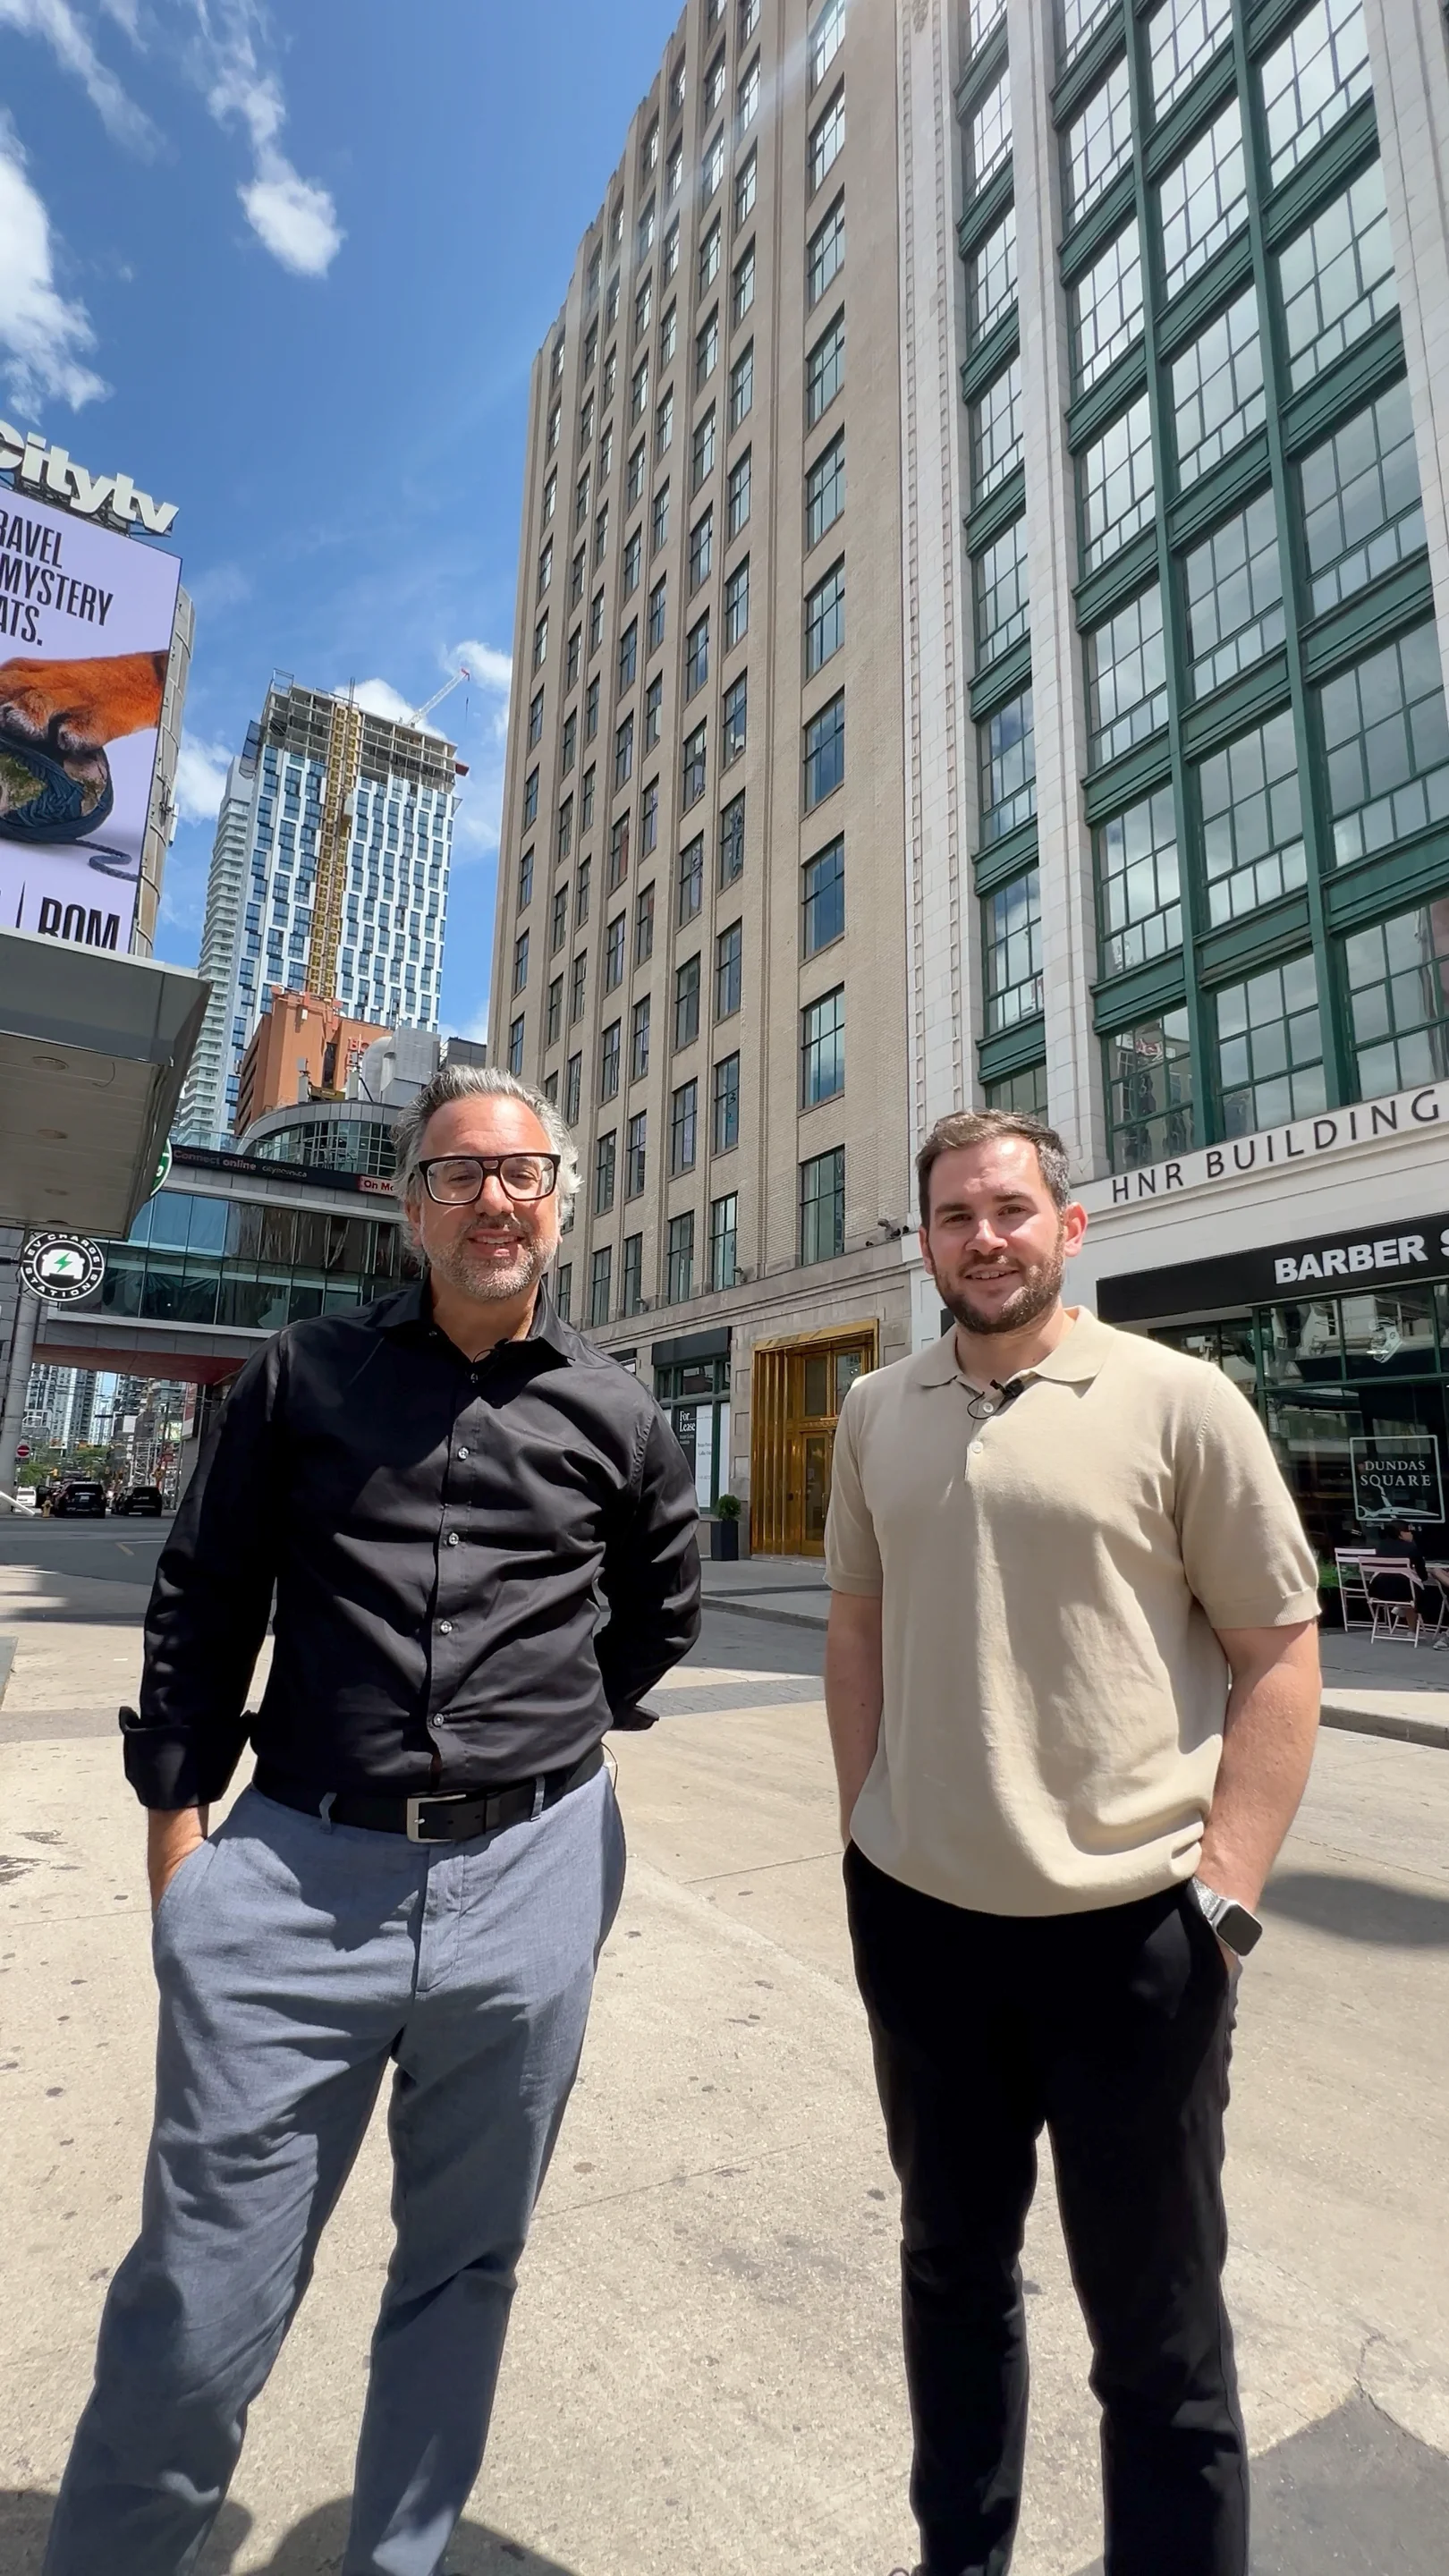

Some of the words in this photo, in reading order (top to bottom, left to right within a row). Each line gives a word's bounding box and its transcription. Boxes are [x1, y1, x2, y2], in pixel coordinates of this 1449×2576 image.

[0, 552, 114, 626] MYSTERY
[1112, 1163, 1184, 1203] HNR
[1206, 1089, 1439, 1178] BUILDING
[223, 1157, 257, 1171] online
[28, 1241, 41, 1256] EV
[47, 1234, 100, 1263] CHARGE
[1275, 1234, 1428, 1284] BARBER
[25, 1267, 98, 1297] STATIONS
[680, 1411, 691, 1421] For
[680, 1422, 696, 1432] Lease
[1364, 1461, 1426, 1471] DUNDAS
[1360, 1474, 1431, 1487] SQUARE
